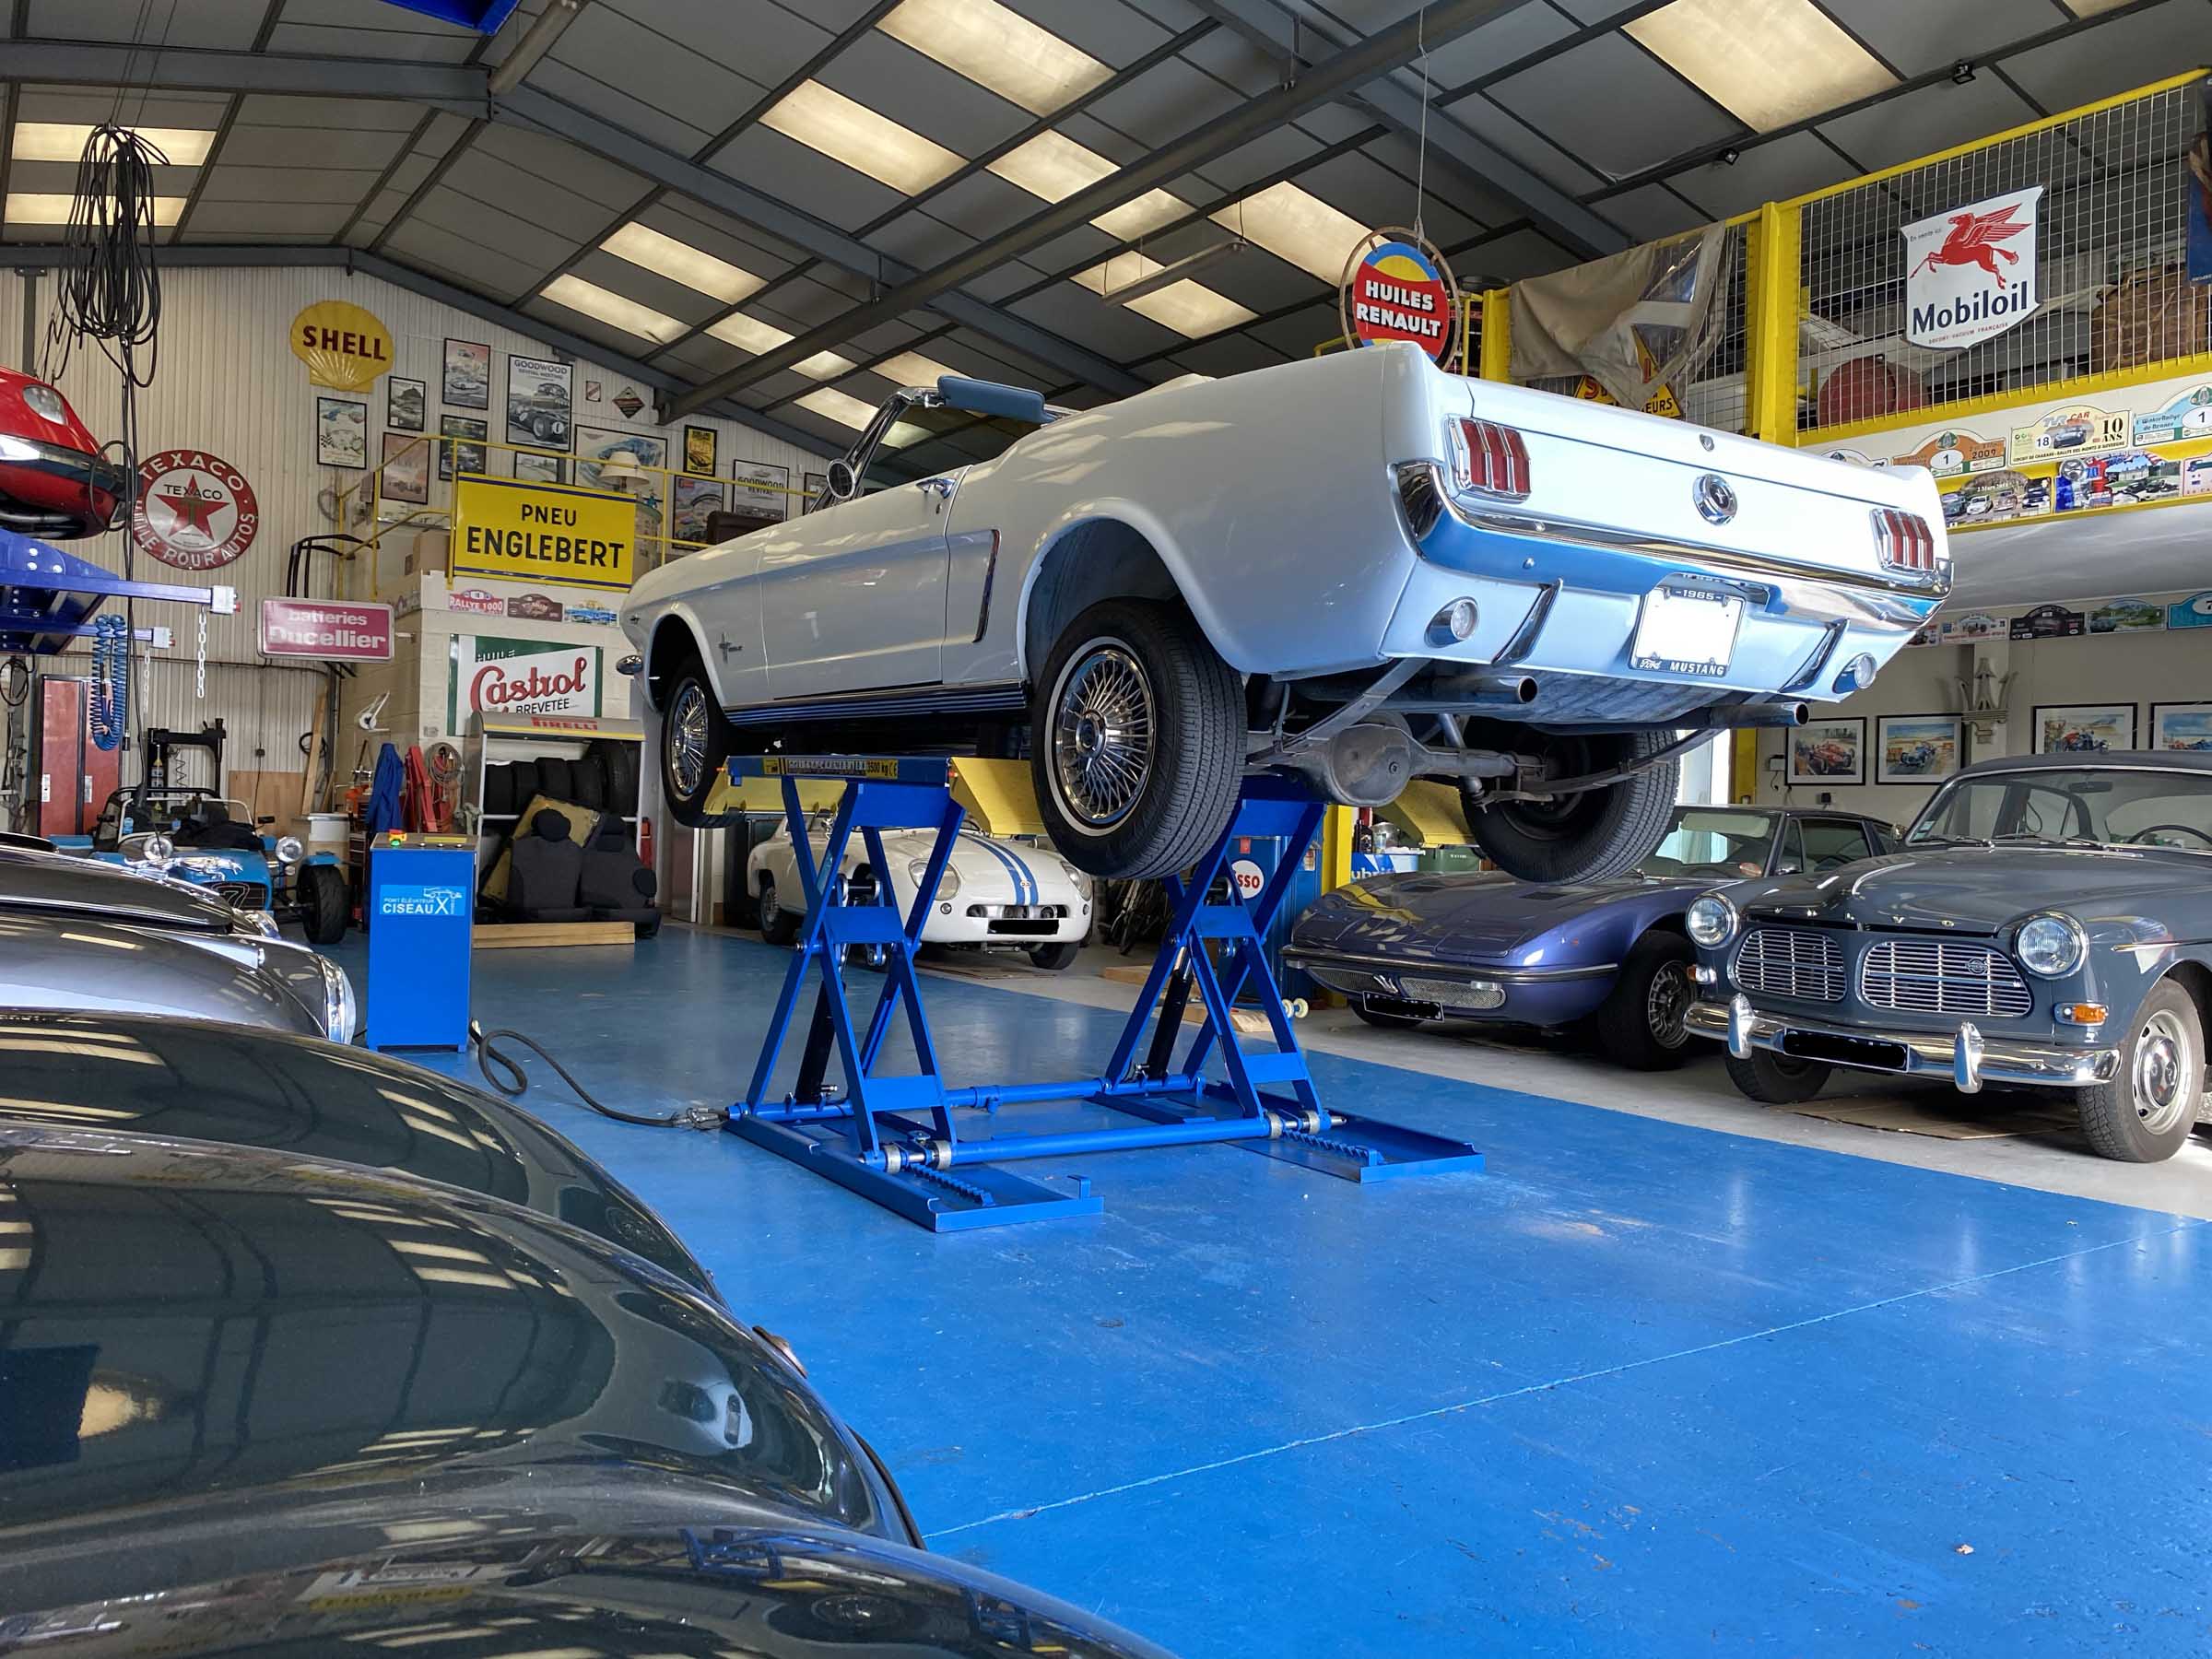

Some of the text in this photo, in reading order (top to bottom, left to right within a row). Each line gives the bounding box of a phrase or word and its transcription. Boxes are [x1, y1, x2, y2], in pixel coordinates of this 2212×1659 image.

[1366, 280, 1433, 312] HUILES
[1912, 281, 2028, 335] Mobiloil
[1357, 302, 1441, 337] RENAULT
[302, 325, 386, 361] SHELL
[513, 359, 568, 375] GOODWOOD
[1642, 397, 1673, 414] EURS
[2070, 411, 2090, 420] CAR
[2198, 411, 2206, 423] 1
[2102, 417, 2124, 435] 10
[2036, 437, 2050, 448] 18
[2101, 433, 2123, 443] ANS
[1943, 453, 1949, 465] 1
[1971, 448, 1996, 459] 2009
[139, 453, 244, 491] TEXACO
[163, 484, 223, 500] TEXACO
[521, 504, 577, 527] PNEU
[163, 547, 217, 568] POUR
[220, 512, 256, 562] AUTOS
[467, 526, 625, 569] ENGLEBERT
[449, 596, 479, 611] RALLYE
[482, 601, 502, 612] 1000
[288, 610, 368, 626] batteries
[268, 626, 386, 649] Ducellier
[475, 649, 515, 663] HUILE
[1639, 658, 1725, 676] Ford MUSTANG
[470, 656, 588, 713] Castrol
[531, 716, 598, 731] PIRELLI
[1236, 875, 1261, 889] SSO
